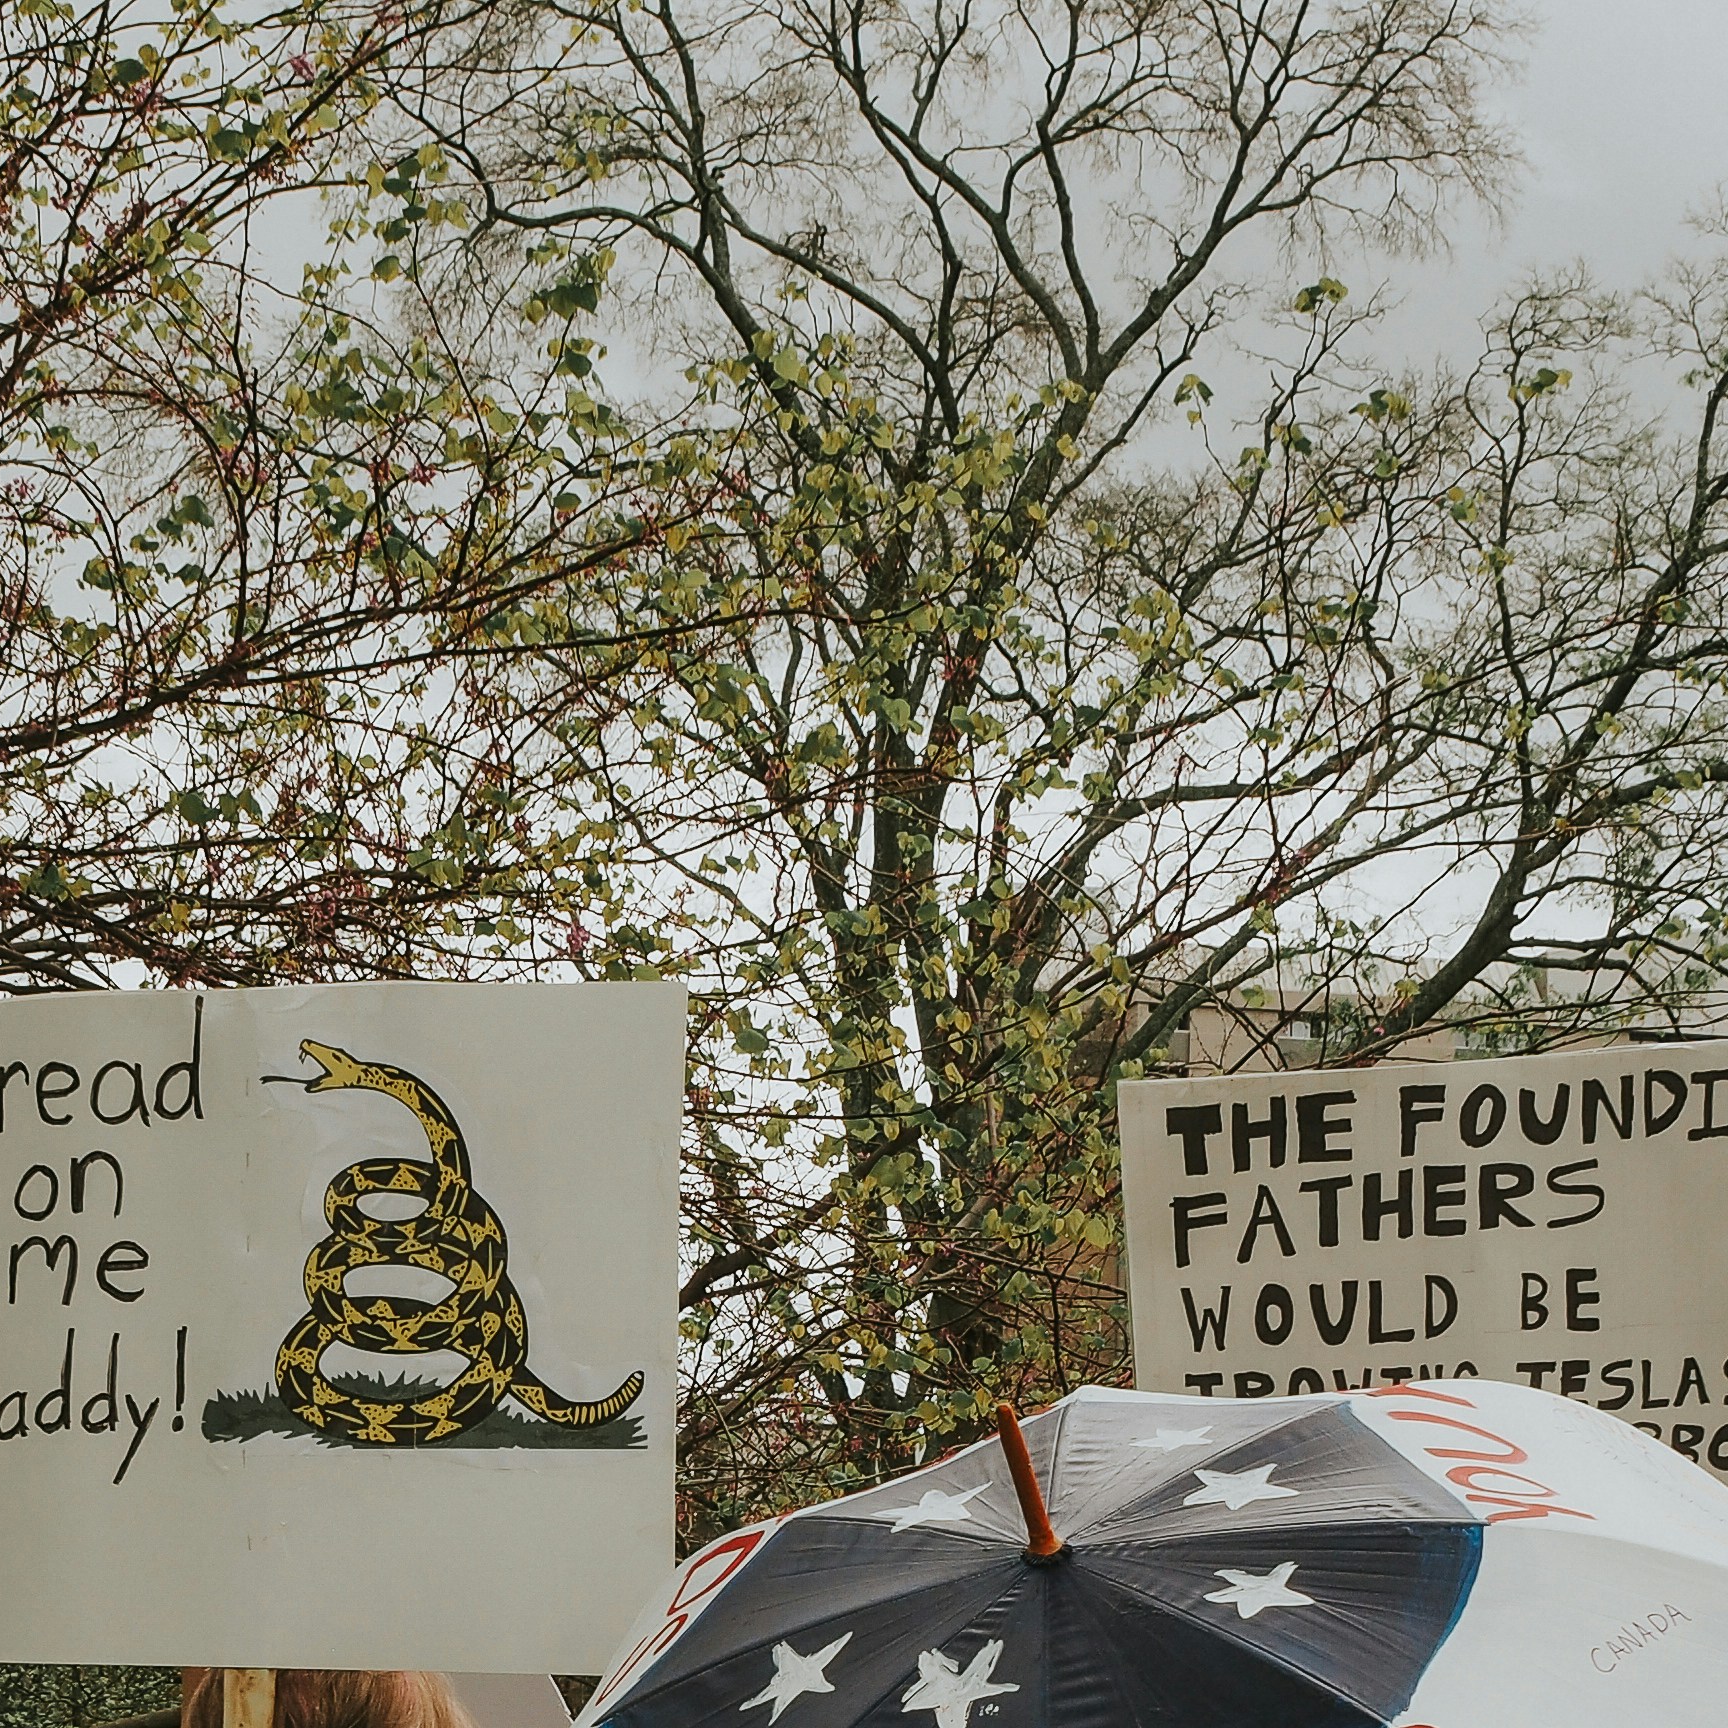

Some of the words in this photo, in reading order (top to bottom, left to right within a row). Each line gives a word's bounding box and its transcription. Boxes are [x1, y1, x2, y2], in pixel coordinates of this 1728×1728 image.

[1166, 1090, 1356, 1176] THE
[13, 1150, 124, 1221] on
[1170, 1158, 1605, 1268] FATHERS
[9, 1235, 149, 1305] me
[1182, 1275, 1457, 1352] WOULD
[1522, 1268, 1601, 1332] BE
[1336, 1383, 1597, 1523] YOU
[1590, 1602, 1692, 1674] CANADA
